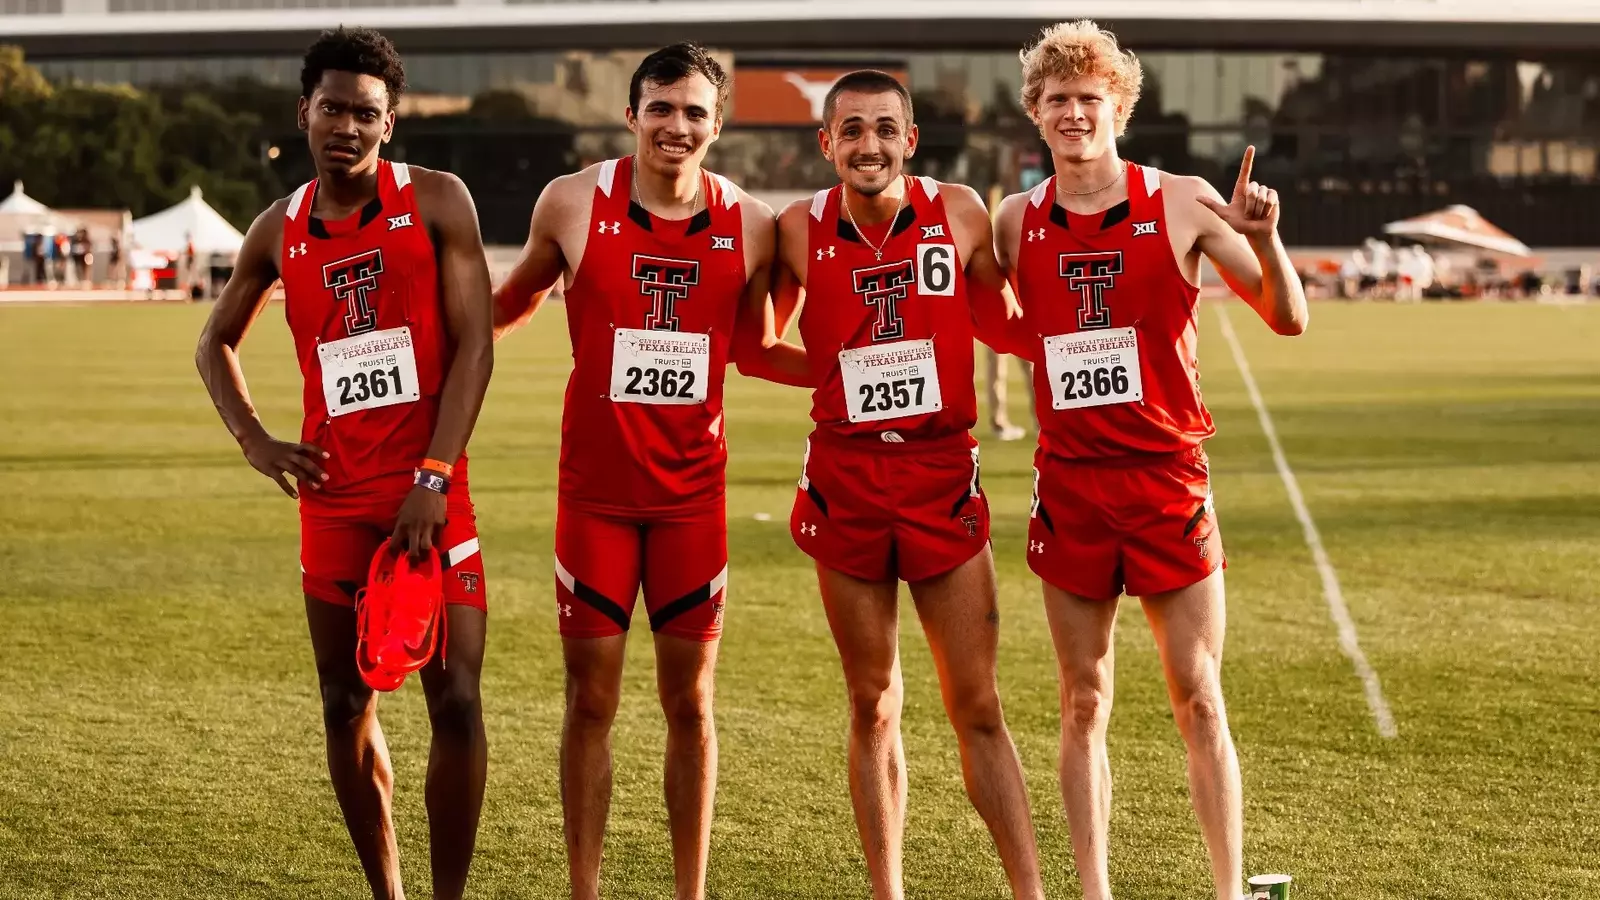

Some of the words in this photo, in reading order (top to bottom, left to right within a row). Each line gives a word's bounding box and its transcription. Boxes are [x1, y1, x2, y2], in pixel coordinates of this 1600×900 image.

[388, 213, 414, 231] XII
[1132, 220, 1158, 237] XII
[920, 224, 945, 240] XII
[711, 235, 735, 250] XII
[922, 246, 951, 292] 6
[342, 347, 372, 360] TEXAS
[374, 340, 411, 353] RELAYS
[638, 344, 671, 353] TEXAS
[672, 346, 707, 355] RELAYS
[1066, 344, 1097, 355] TEXAS
[1099, 340, 1136, 351] RELAYS
[358, 358, 384, 368] TRUIST
[654, 358, 680, 366] TRUIST
[863, 357, 896, 368] TEXAS
[897, 351, 933, 364] RELAYS
[1083, 356, 1109, 366] TRUIST
[881, 369, 907, 378] TRUIST
[336, 366, 403, 406] 2361
[625, 366, 695, 399] 2362
[1061, 365, 1129, 400] 2366
[859, 377, 925, 413] 2357
